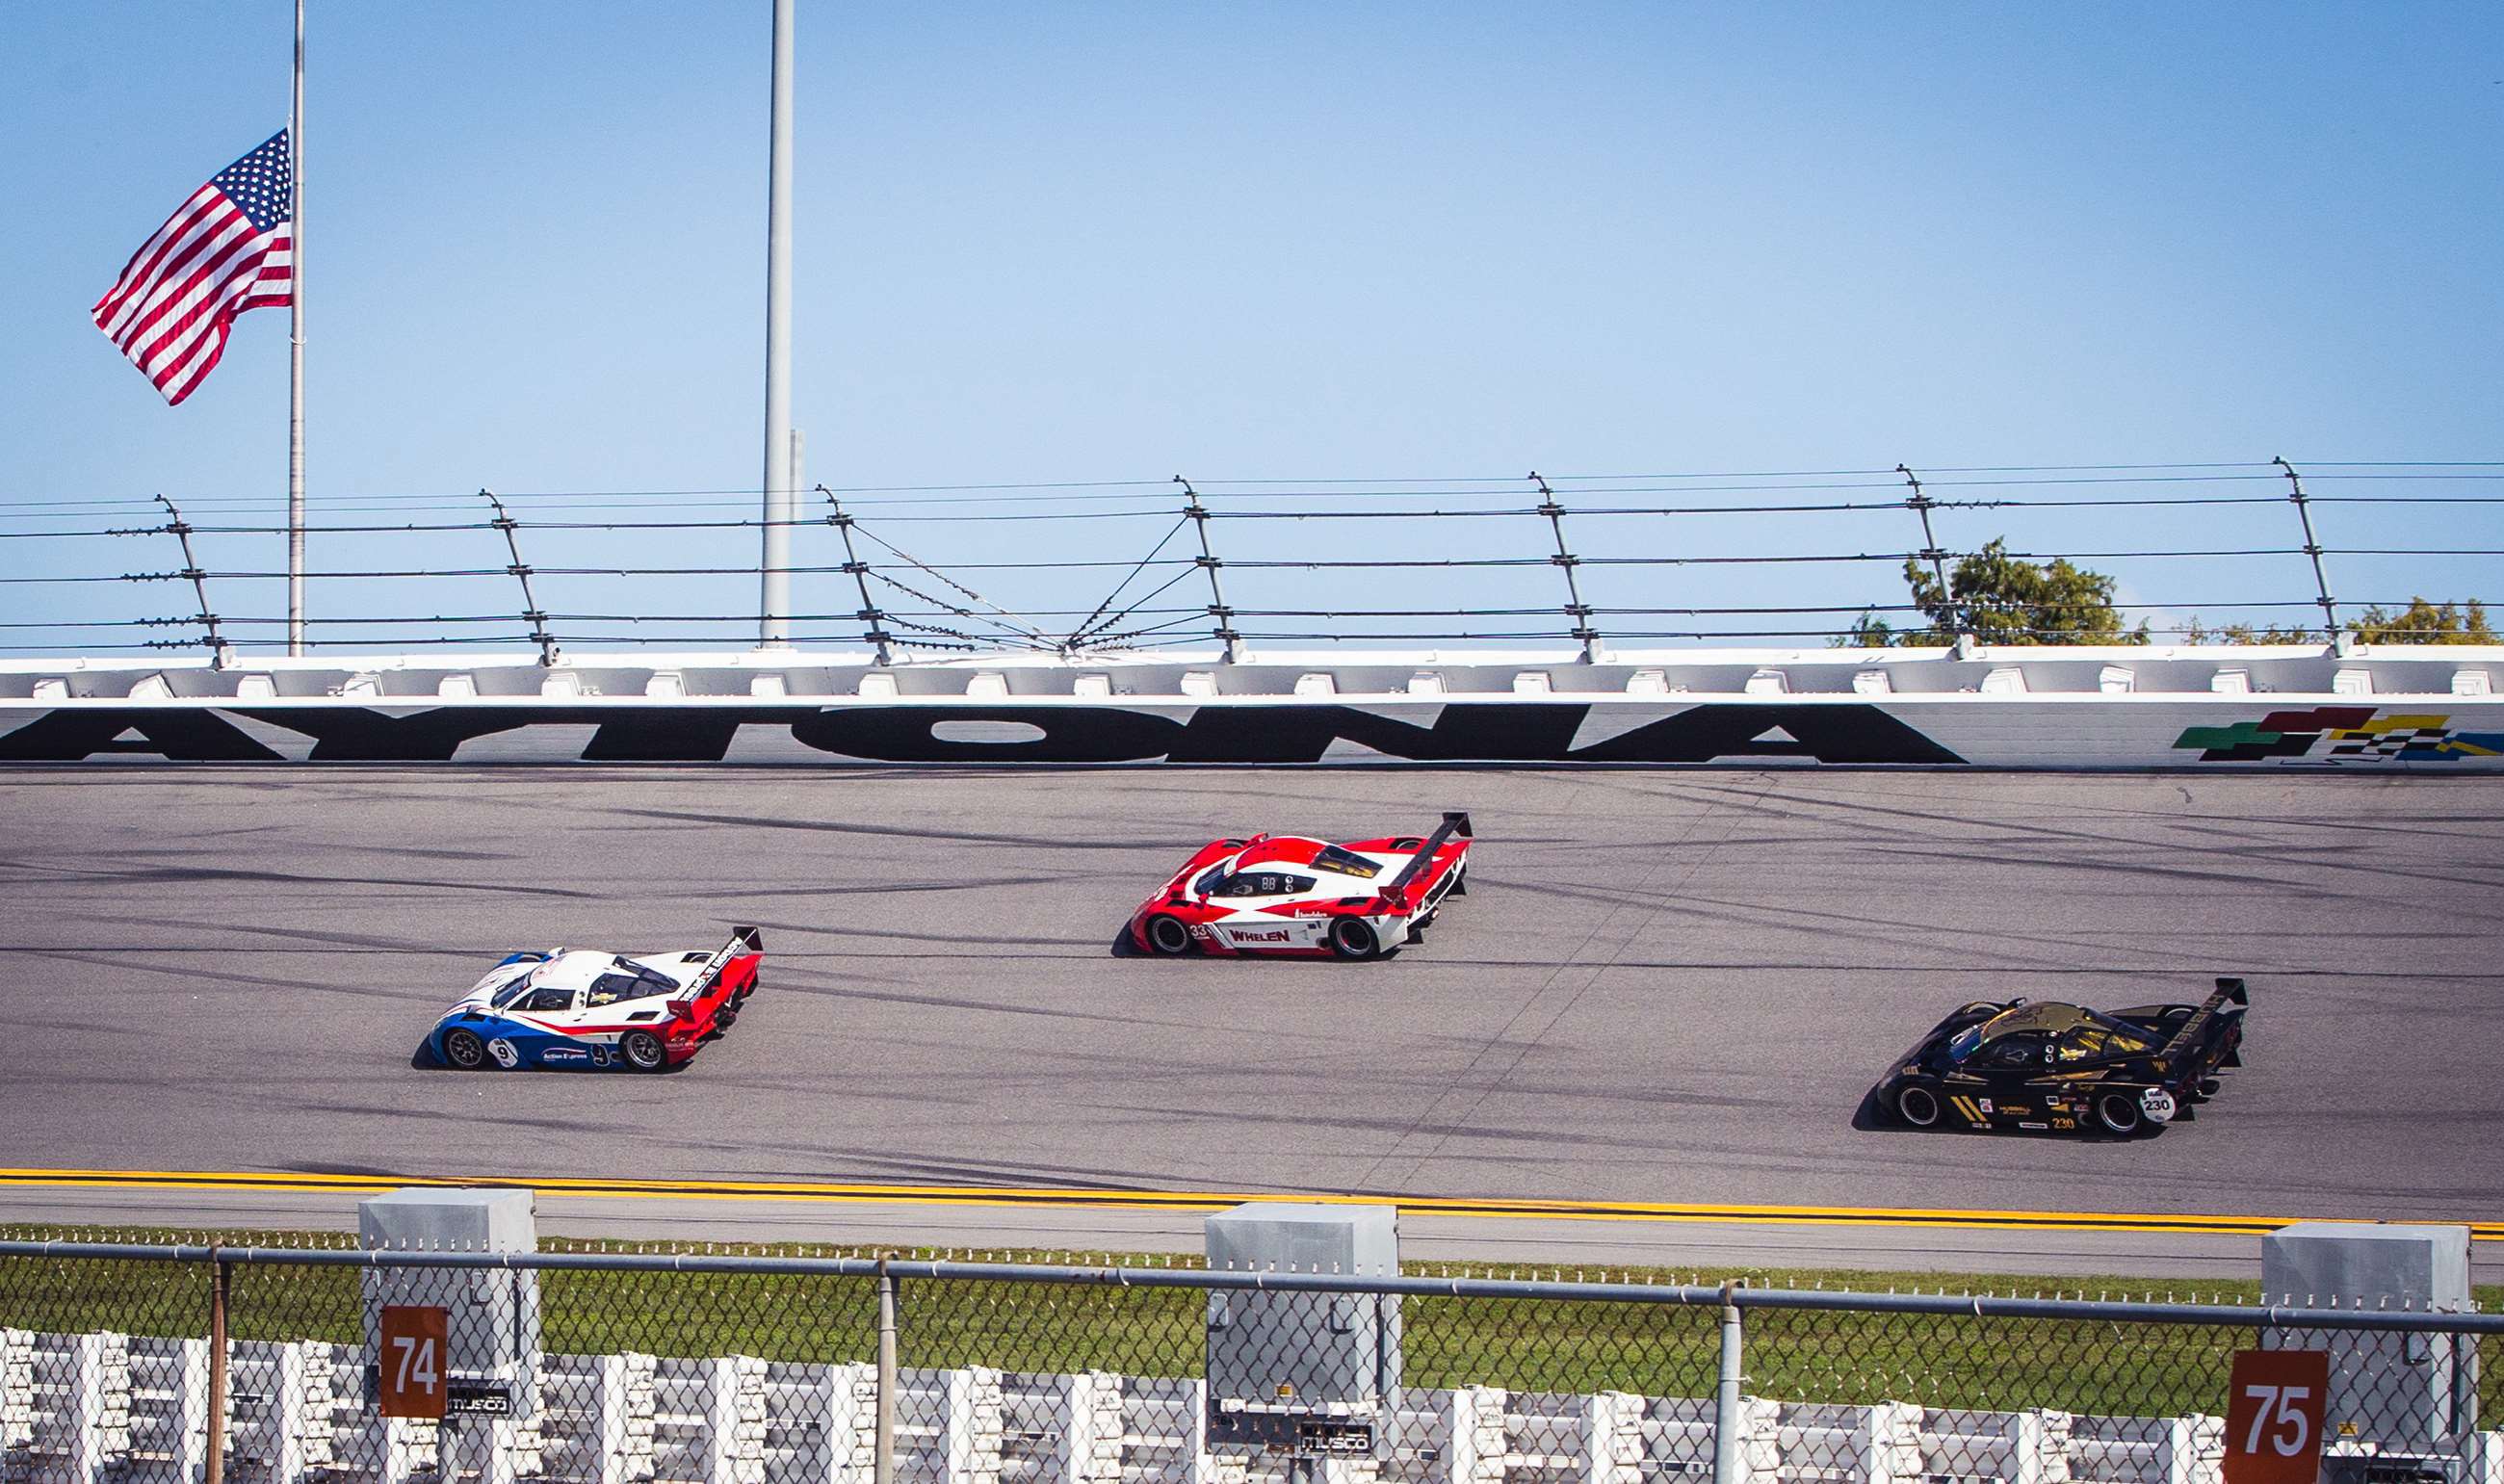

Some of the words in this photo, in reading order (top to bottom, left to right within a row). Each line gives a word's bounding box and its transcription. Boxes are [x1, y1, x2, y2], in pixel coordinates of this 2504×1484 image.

[1188, 924, 1206, 937] 33
[1229, 929, 1291, 942] WHELEN
[497, 1046, 509, 1059] 9
[2144, 1100, 2170, 1111] 230
[2052, 1117, 2075, 1129] 230
[393, 1337, 437, 1394] 74
[2245, 1385, 2310, 1457] 75
